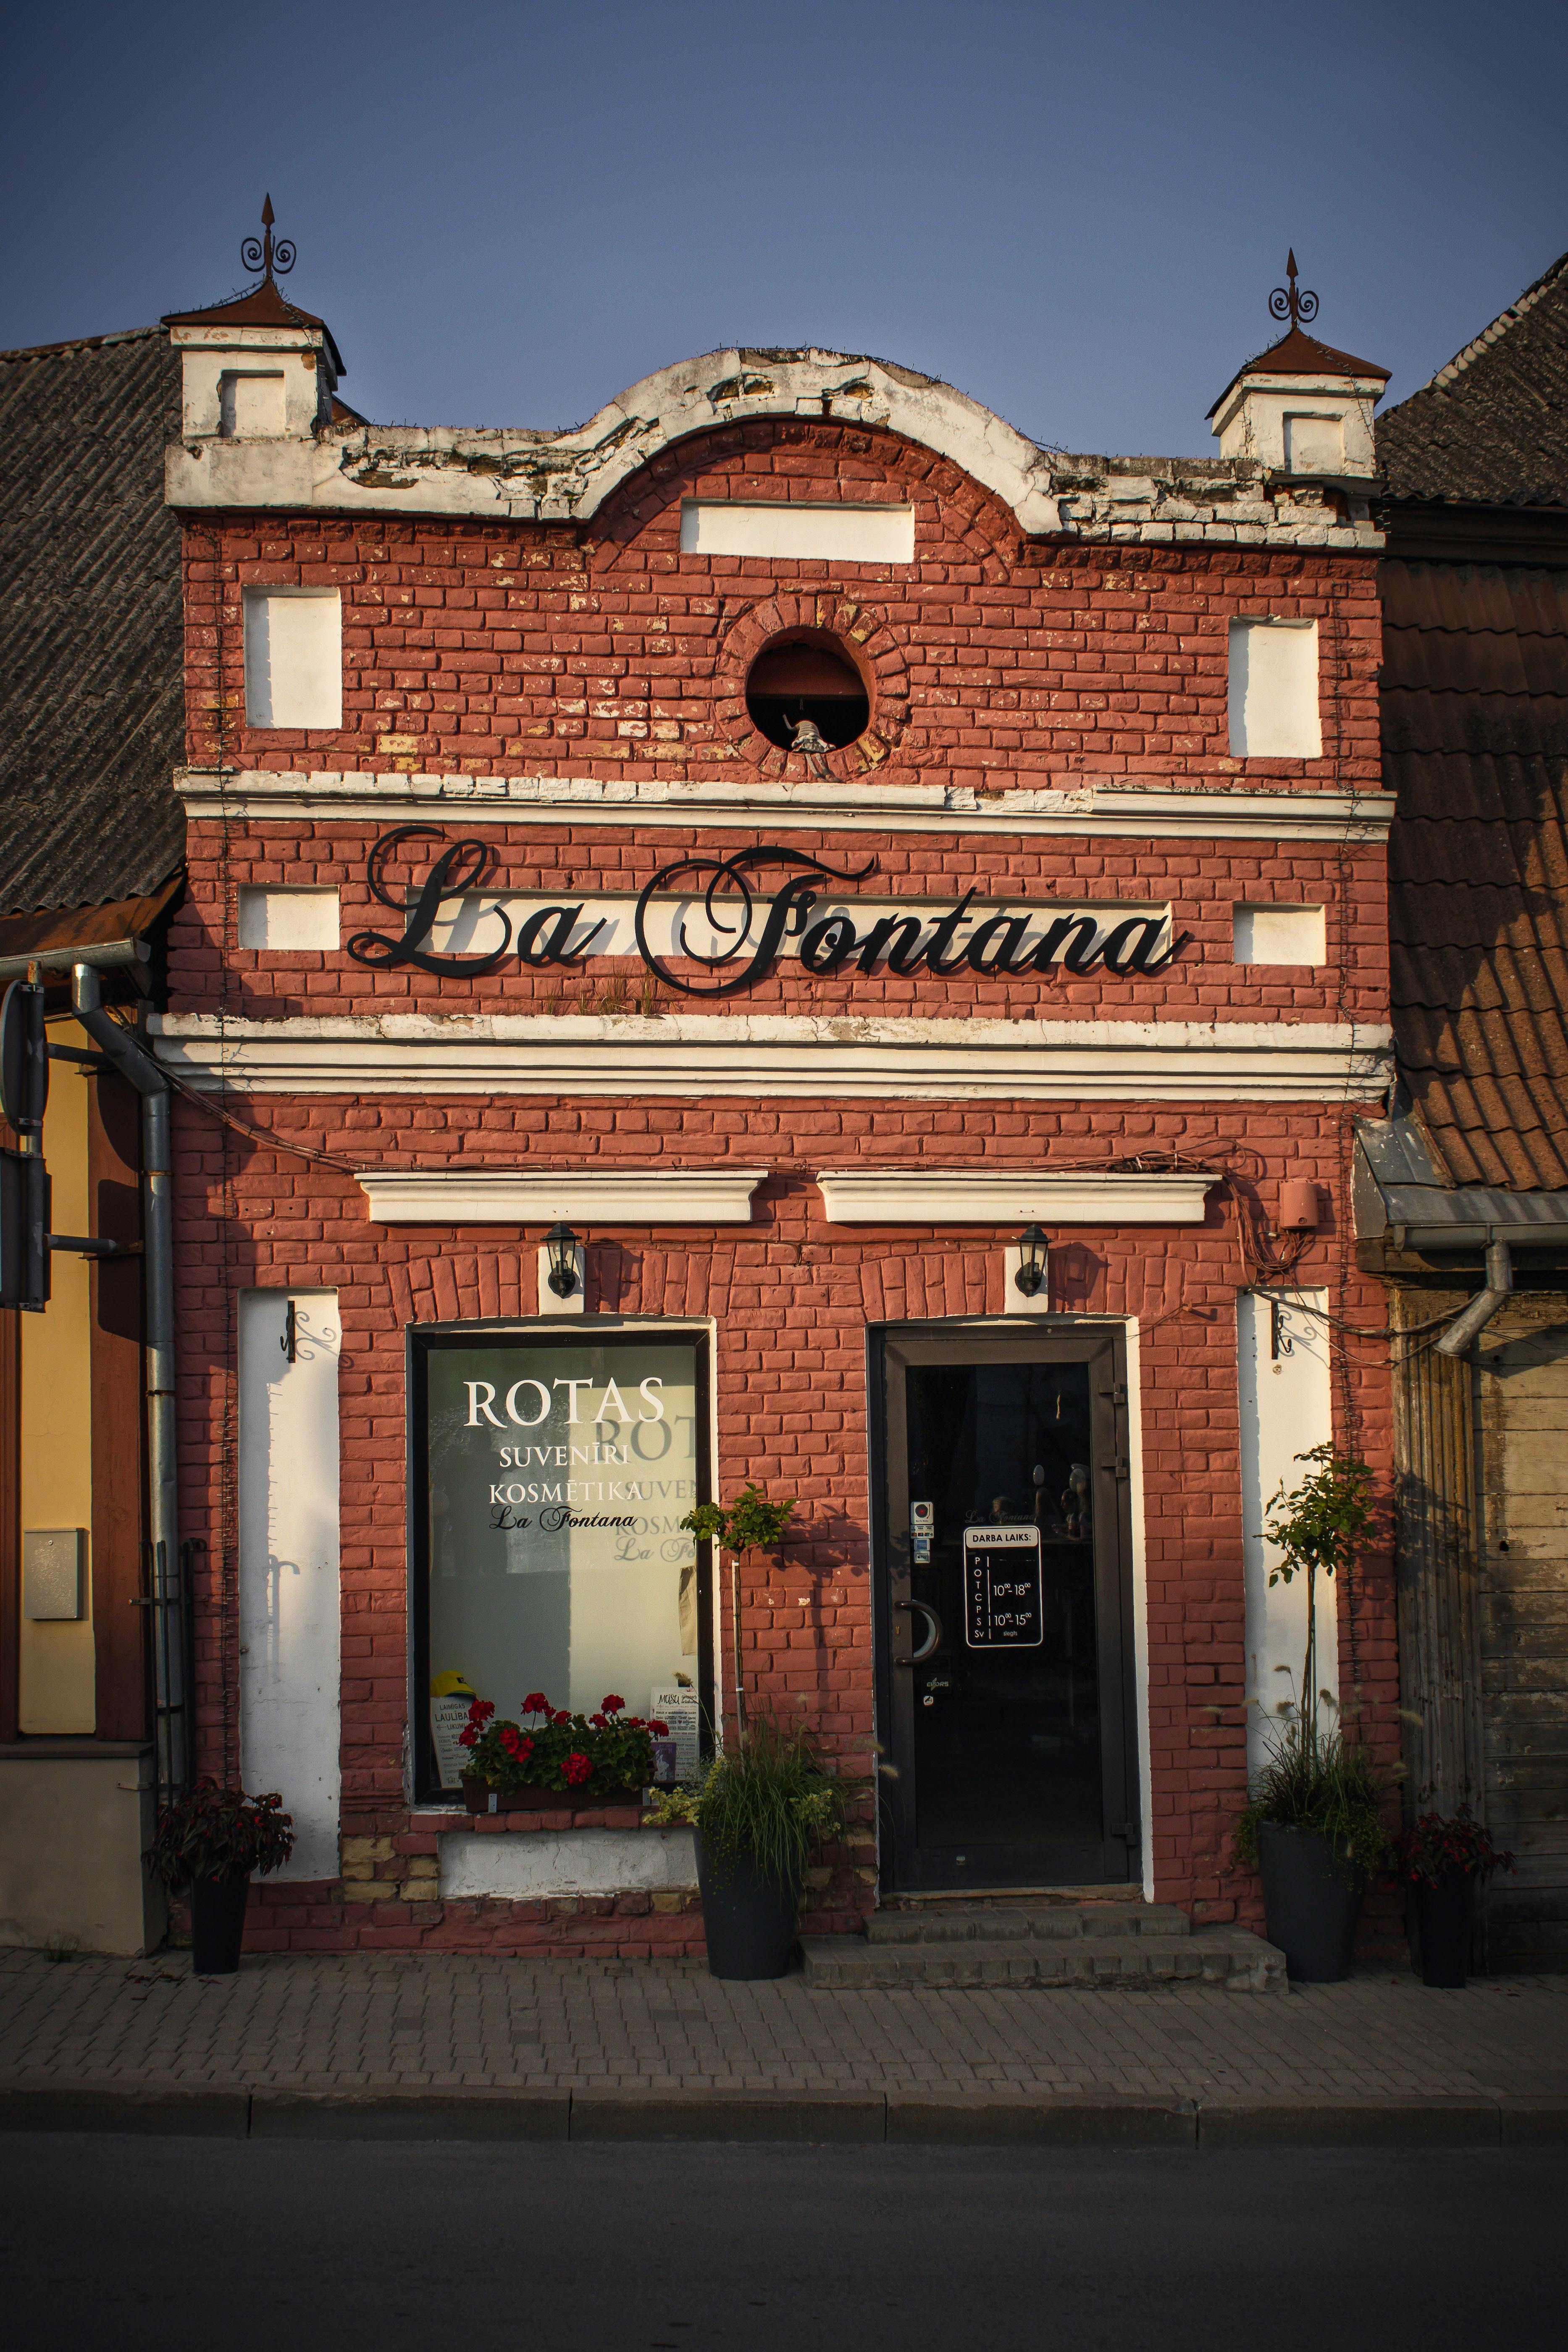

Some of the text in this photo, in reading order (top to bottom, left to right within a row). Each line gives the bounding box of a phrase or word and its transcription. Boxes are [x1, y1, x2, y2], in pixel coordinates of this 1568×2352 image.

[347, 824, 1195, 995] La Fontana
[463, 1377, 664, 1428] ROTAS
[500, 1442, 630, 1467] SUVENĪRI
[489, 1480, 643, 1504] KOSMĒTIKA
[489, 1504, 638, 1532] La Fontana
[965, 1510, 1035, 1523] La Fontana
[435, 1711, 469, 1722] LAULĪBA
